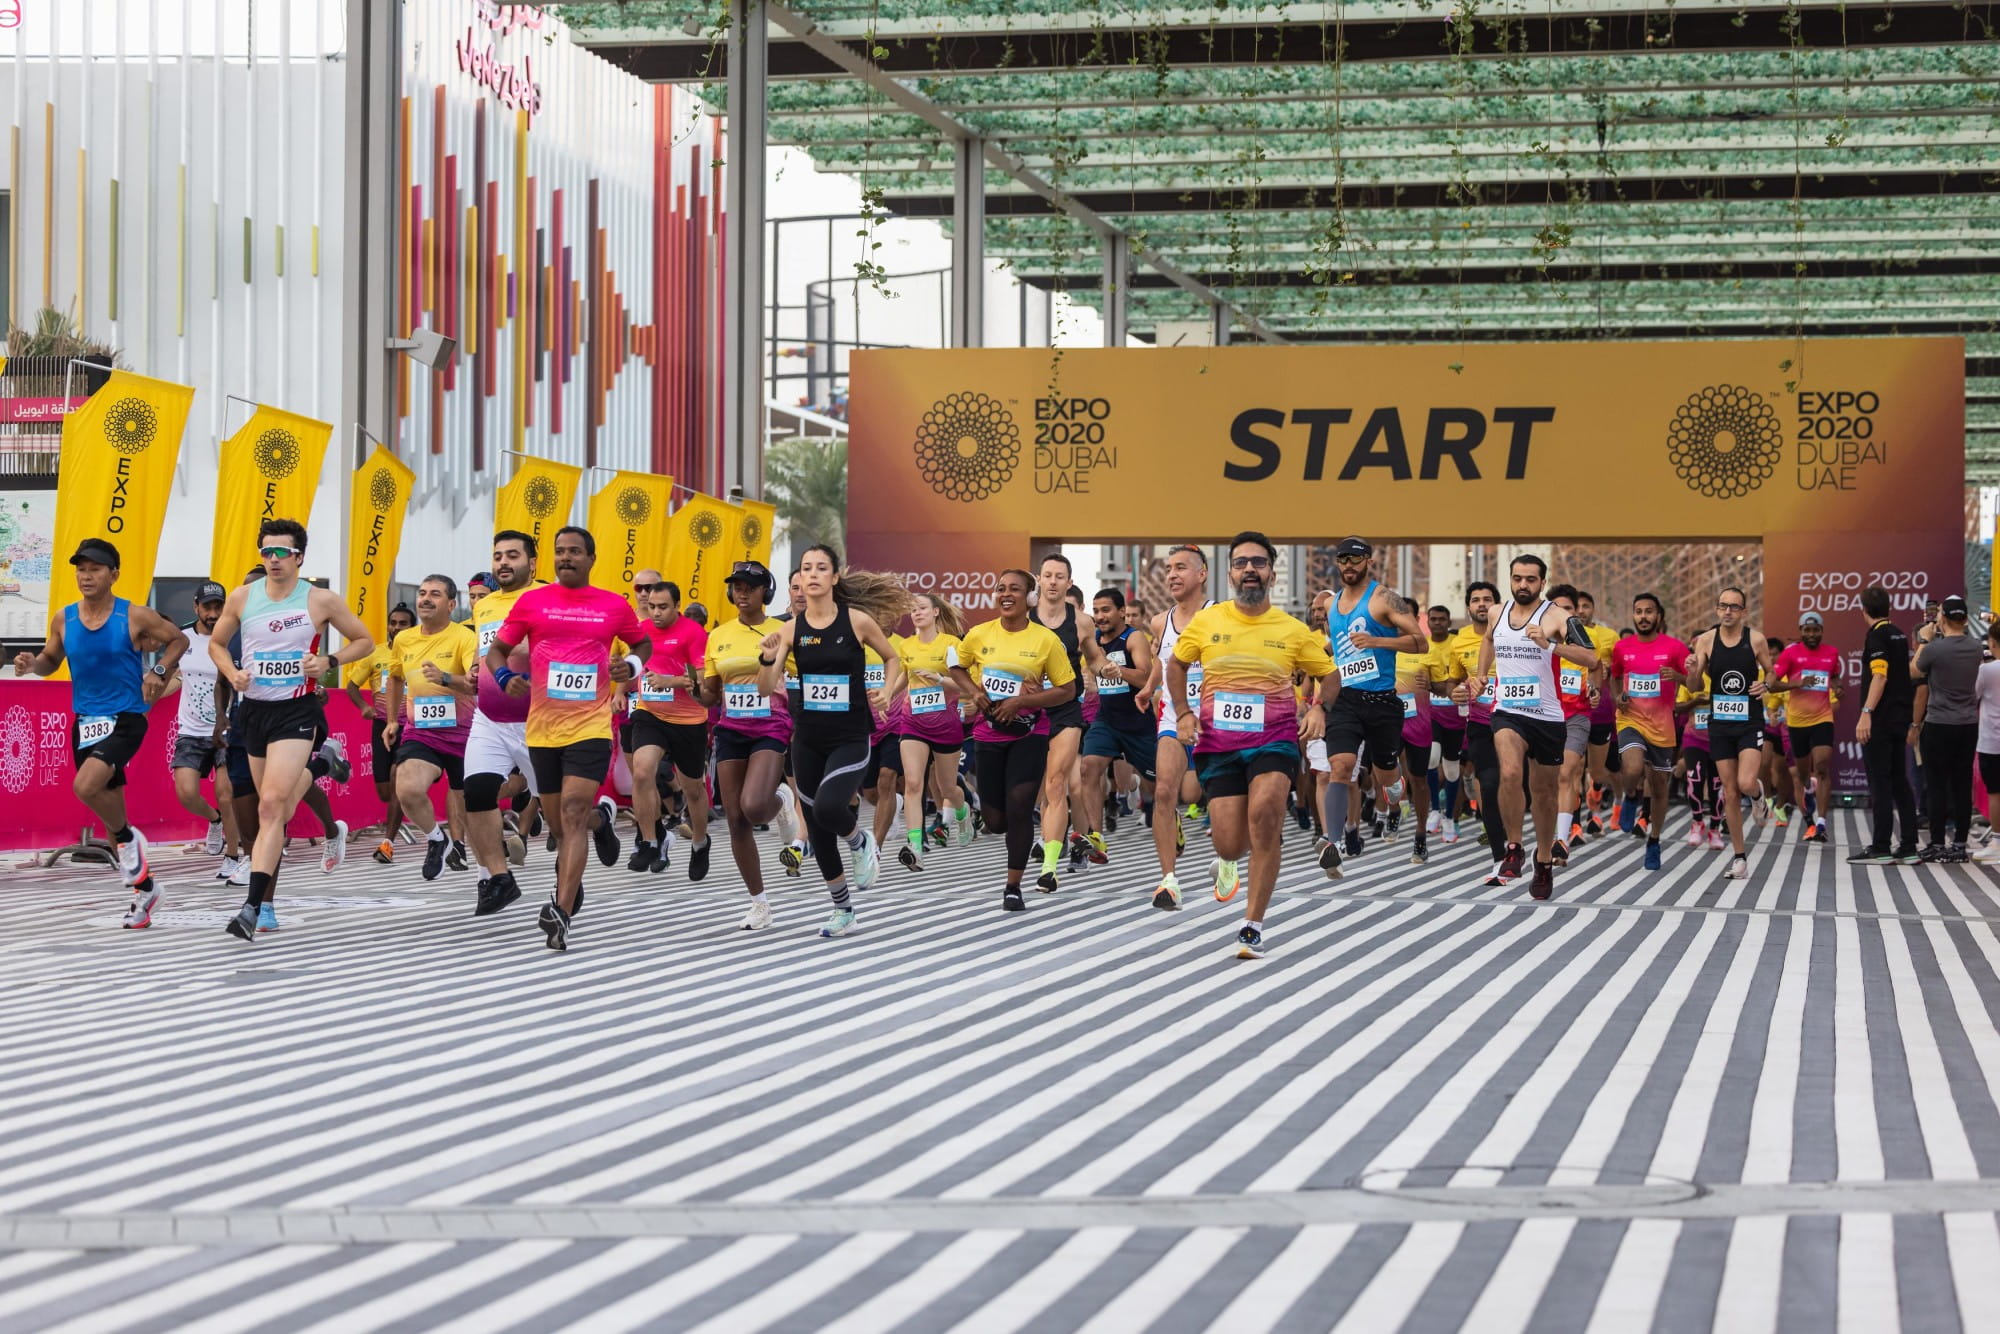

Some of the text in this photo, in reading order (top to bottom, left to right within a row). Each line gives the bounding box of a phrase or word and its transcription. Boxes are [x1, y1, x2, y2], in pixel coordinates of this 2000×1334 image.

[1035, 398, 1111, 420] EXPO
[1798, 391, 1879, 414] EXPO
[1035, 423, 1104, 445] 2020
[1798, 417, 1873, 439] 2020
[1224, 406, 1556, 481] START
[1035, 447, 1117, 469] DUBAI
[1798, 441, 1886, 465] DUBAI
[1035, 471, 1090, 494] UAE
[1798, 467, 1857, 490] UAE
[107, 457, 131, 533] EXPO
[363, 515, 385, 576] EXPO
[622, 529, 637, 583] EXPO
[893, 572, 996, 589] XPO 2020
[1798, 572, 1928, 590] EXPO 2020
[1798, 594, 1863, 612] DUBA
[258, 661, 300, 676] 16805
[1342, 658, 1375, 677] 16095
[555, 674, 592, 688] 1067
[984, 678, 1016, 694] 4095
[1632, 680, 1656, 690] 1580
[811, 686, 839, 699] 234
[914, 693, 941, 706] 4797
[1504, 685, 1534, 697] 3854
[729, 694, 762, 707] 4121
[1716, 702, 1744, 712] 4640
[421, 705, 446, 718] 939
[1223, 704, 1253, 720] 888
[41, 712, 67, 730] EXPO
[84, 722, 109, 739] 3383
[41, 731, 65, 748] 2020
[41, 750, 69, 767] DUBAI
[361, 743, 373, 758] EXP
[41, 768, 60, 785] UAE
